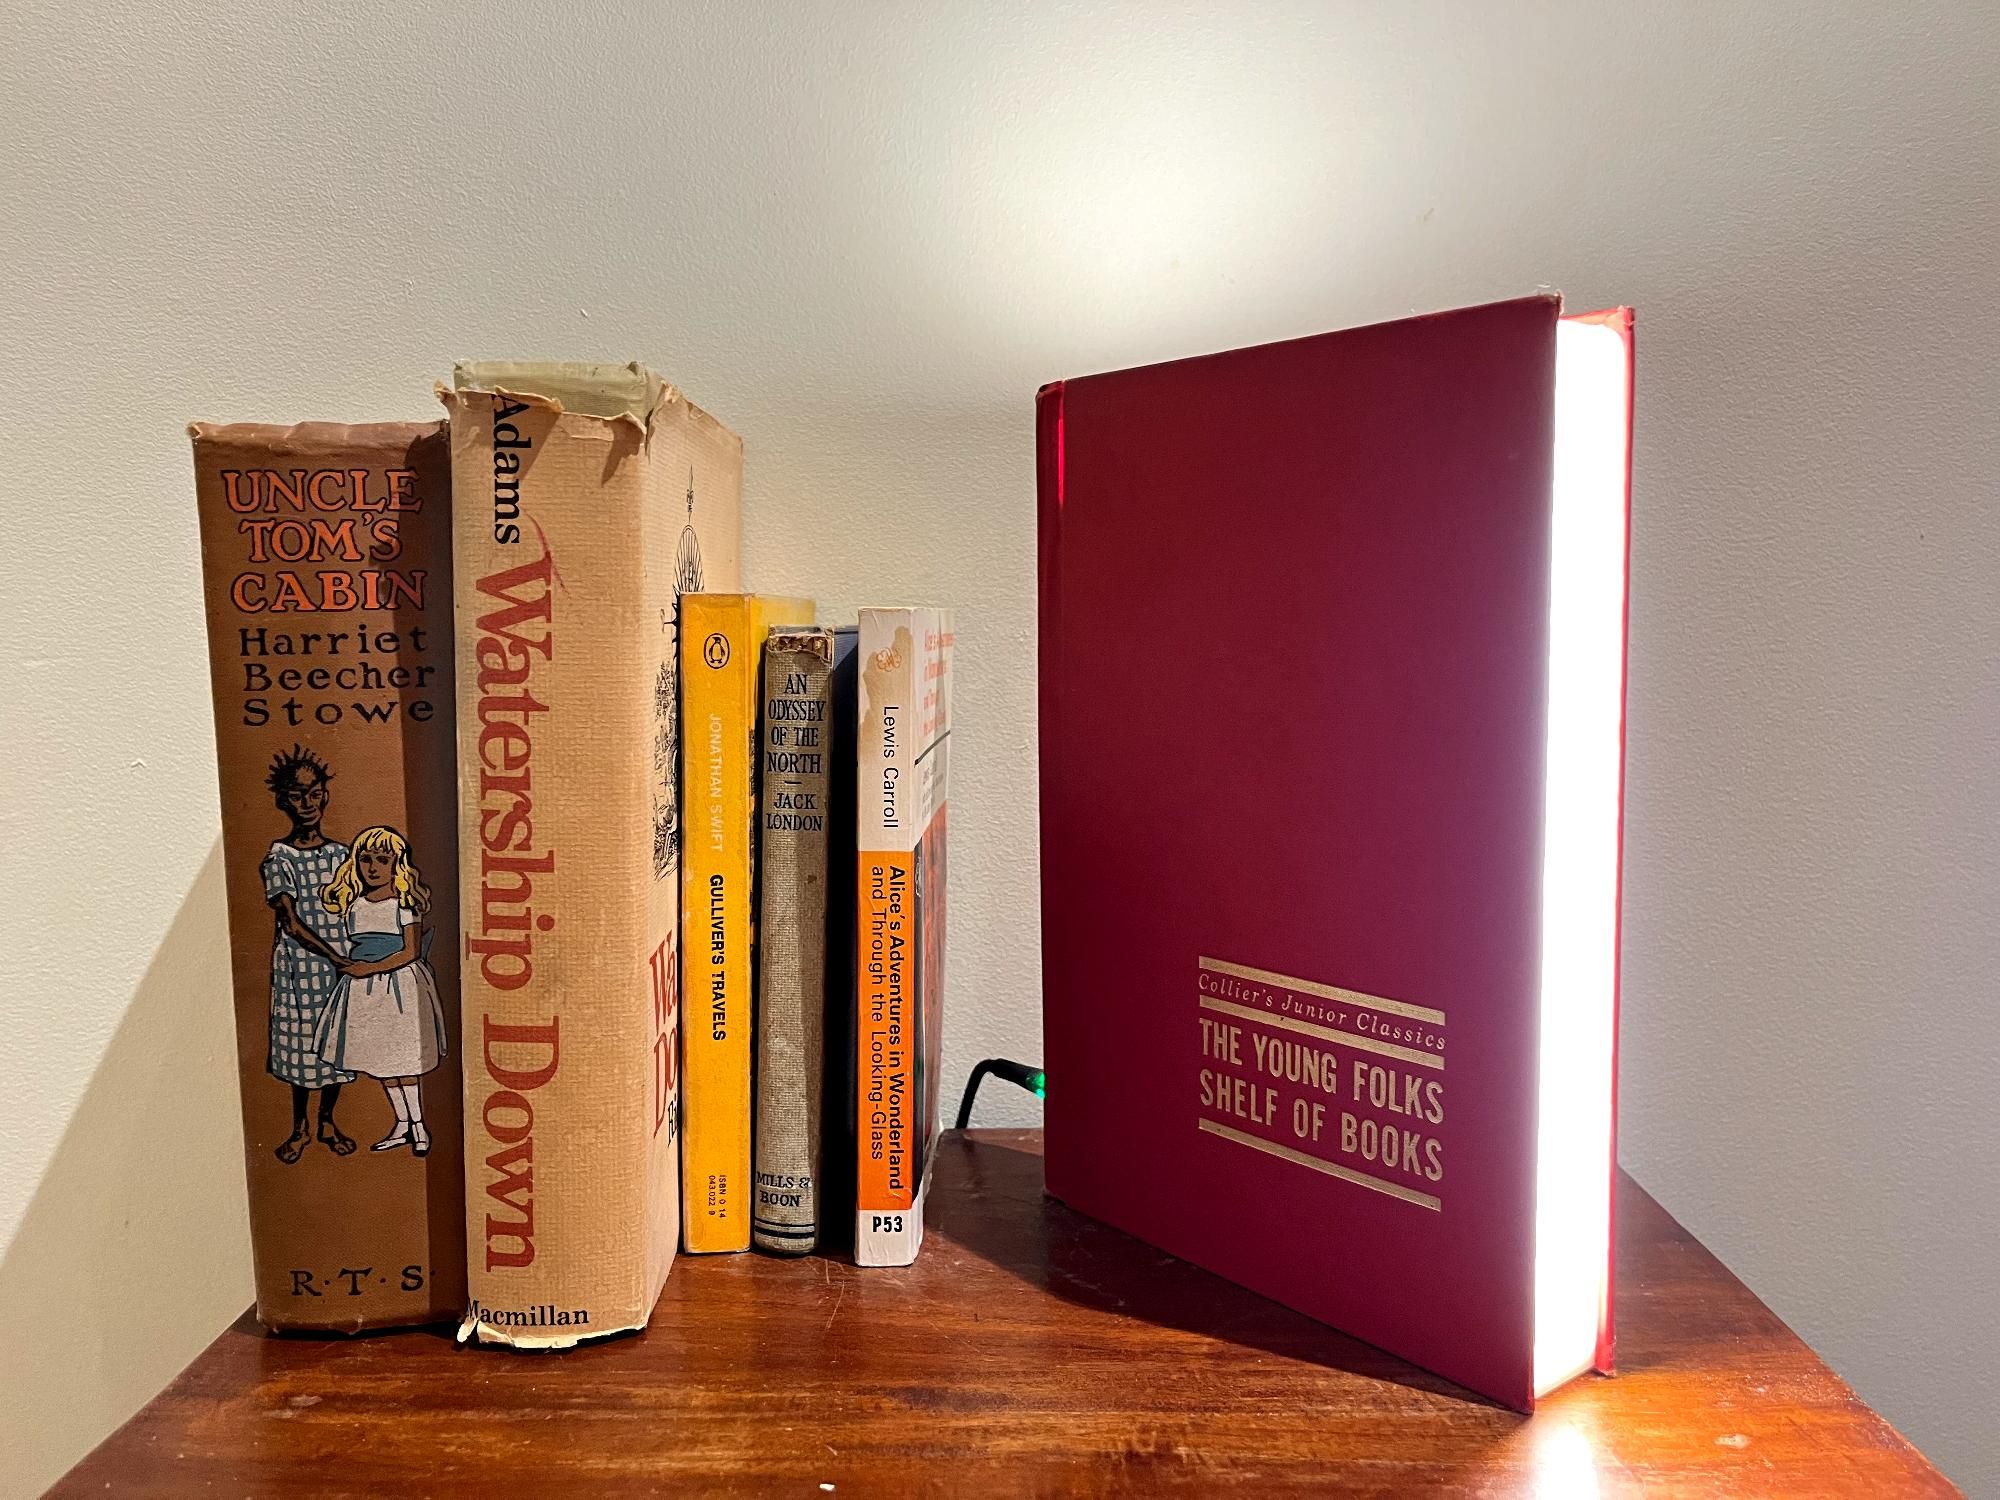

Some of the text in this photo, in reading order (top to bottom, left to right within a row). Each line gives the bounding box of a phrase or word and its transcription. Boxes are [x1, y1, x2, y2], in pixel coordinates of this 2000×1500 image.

[491, 393, 531, 544] Adams
[221, 467, 422, 513] UNCLE
[239, 513, 403, 563] TOM'S
[231, 570, 427, 613] CABIN
[239, 624, 427, 657] Harriet
[243, 662, 435, 692] Beecher
[784, 673, 807, 695] AN
[243, 697, 434, 727] Stowe
[768, 700, 826, 722] ODYSSEY
[771, 727, 819, 747] OF THE
[767, 752, 822, 774] NORTH
[883, 706, 899, 828] Lewis Carroll
[709, 713, 724, 851] JONATHAN SWIFT
[774, 792, 818, 810] JACK
[766, 814, 823, 832] LONDON
[465, 551, 560, 1272] Watership Down
[709, 873, 726, 1041] GULLIVER'S TRAVELS
[868, 866, 887, 1160] and Through the Looking-Glass
[1199, 973, 1446, 1049] Collier's Junior Classics
[889, 865, 905, 1189] Alice's Adventures in Wonderland
[1199, 1017, 1444, 1124] THE YOUNG FOLKS
[1200, 1068, 1443, 1182] SHELF OF BOOKS
[718, 1174, 727, 1195] ISBN
[756, 1171, 811, 1188] MILLS &
[718, 1208, 727, 1218] 14
[760, 1189, 801, 1207] BOON
[872, 1215, 903, 1233] P53
[467, 1299, 590, 1326] Macmillan
